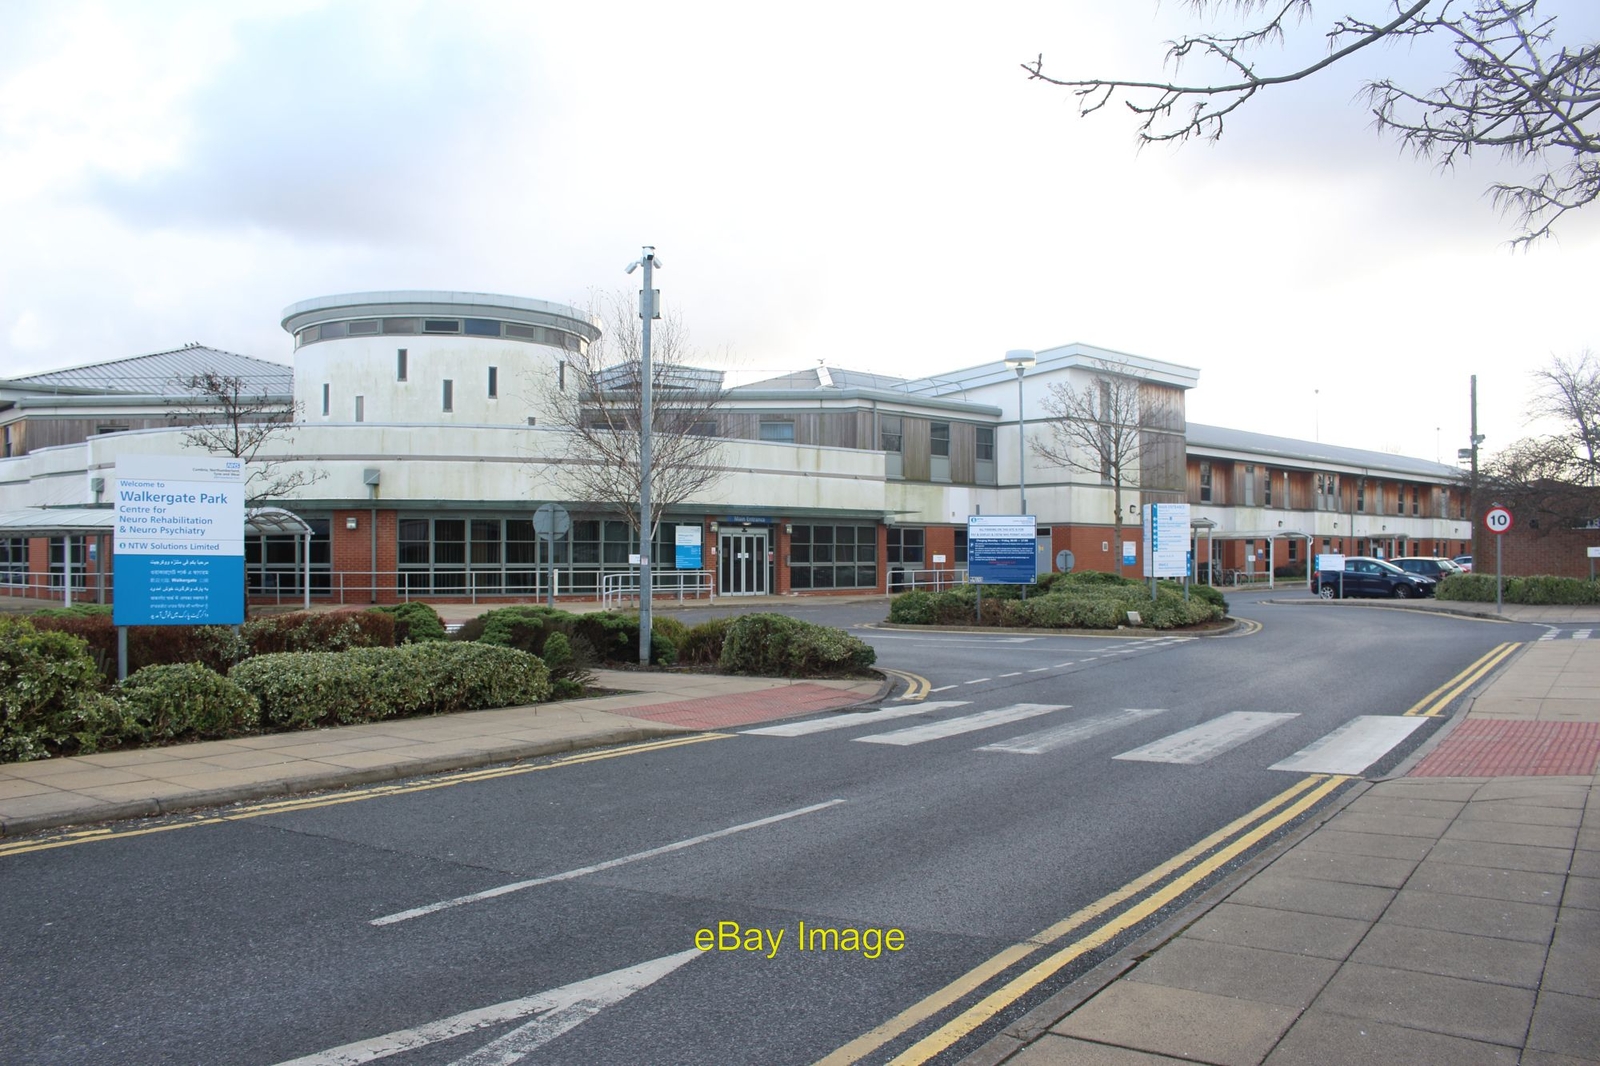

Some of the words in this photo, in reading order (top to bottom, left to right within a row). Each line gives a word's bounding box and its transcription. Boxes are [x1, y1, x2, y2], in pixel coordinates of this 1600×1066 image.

[120, 480, 155, 488] Welcome
[120, 490, 196, 505] Walkergate
[200, 493, 228, 504] Park
[119, 505, 151, 514] Centre
[153, 506, 167, 514] for
[119, 515, 148, 524] Neuro
[150, 516, 213, 525] Rehabilitation
[1490, 514, 1507, 526] 10
[119, 526, 127, 534] &
[129, 526, 158, 534] Neuro
[160, 526, 206, 537] Psychiatry
[190, 543, 220, 551] Limited
